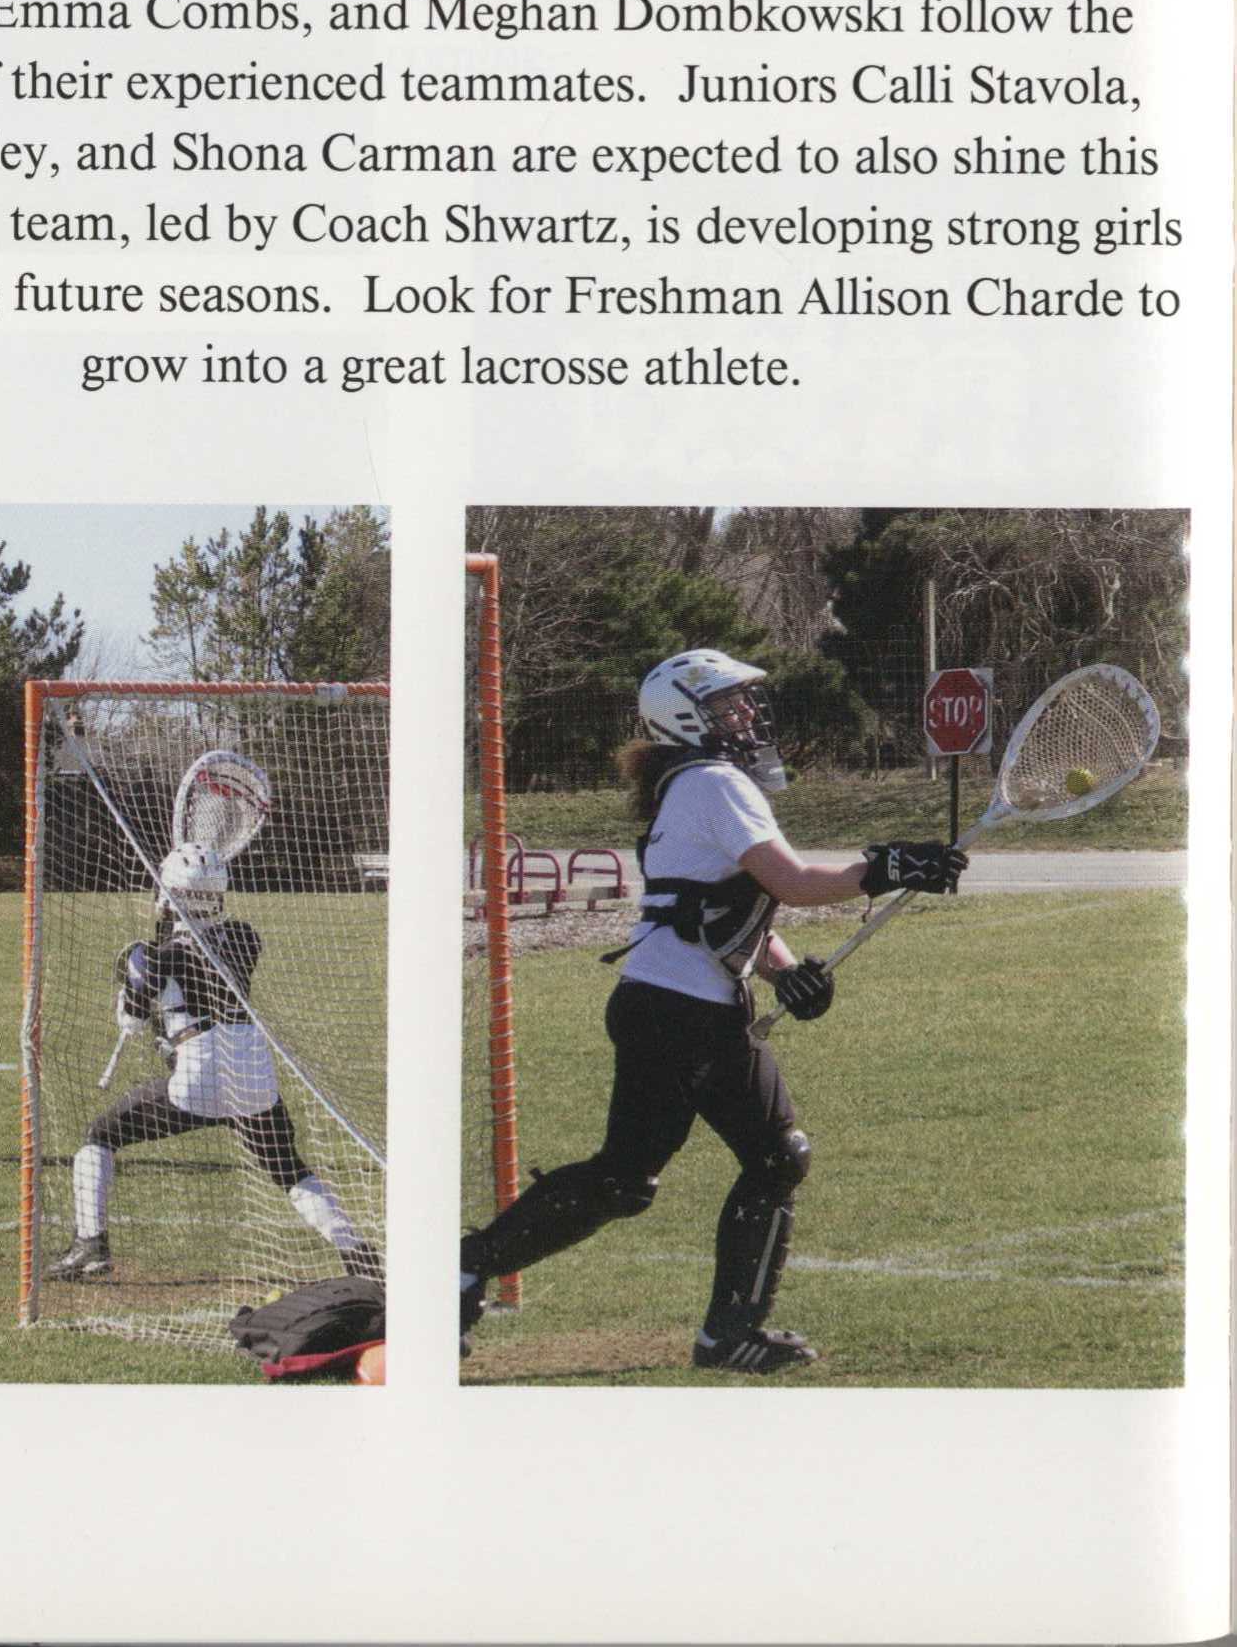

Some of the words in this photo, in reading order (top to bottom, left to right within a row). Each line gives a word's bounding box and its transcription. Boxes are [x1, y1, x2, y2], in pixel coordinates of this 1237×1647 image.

[11, 59, 113, 100] their
[126, 60, 386, 109] experienced
[400, 67, 646, 103] teammates.
[678, 63, 837, 104] Juniors
[852, 64, 954, 104] Calli
[970, 64, 1140, 112] Stavola,
[76, 131, 157, 171] and
[173, 131, 308, 172] Shona
[322, 132, 497, 173] Carman
[512, 145, 577, 173] are
[592, 135, 782, 182] expected
[796, 140, 839, 175] to
[855, 135, 938, 175] also
[954, 135, 1066, 176] shine
[1080, 136, 1159, 176] this
[10, 206, 130, 250] team,
[146, 202, 212, 242] led
[225, 202, 278, 252] by
[292, 203, 429, 243] Coach
[445, 204, 631, 252] Shwartz,
[647, 204, 680, 245] is
[696, 205, 933, 255] developing
[947, 212, 1080, 255] strong
[1093, 206, 1182, 255] girls
[14, 272, 143, 313] future
[159, 284, 331, 313] seasons.
[364, 274, 476, 314] Look
[489, 274, 552, 314] for
[565, 275, 783, 315] Freshman
[797, 276, 952, 316] Allison
[966, 277, 1123, 317] Charde
[1138, 283, 1180, 317] to
[81, 355, 188, 392] grow
[202, 343, 287, 384] into
[304, 356, 327, 384] a
[341, 350, 446, 393] great
[461, 345, 628, 386] lacrosse
[644, 346, 800, 386] athlete.
[928, 695, 982, 729] STOP
